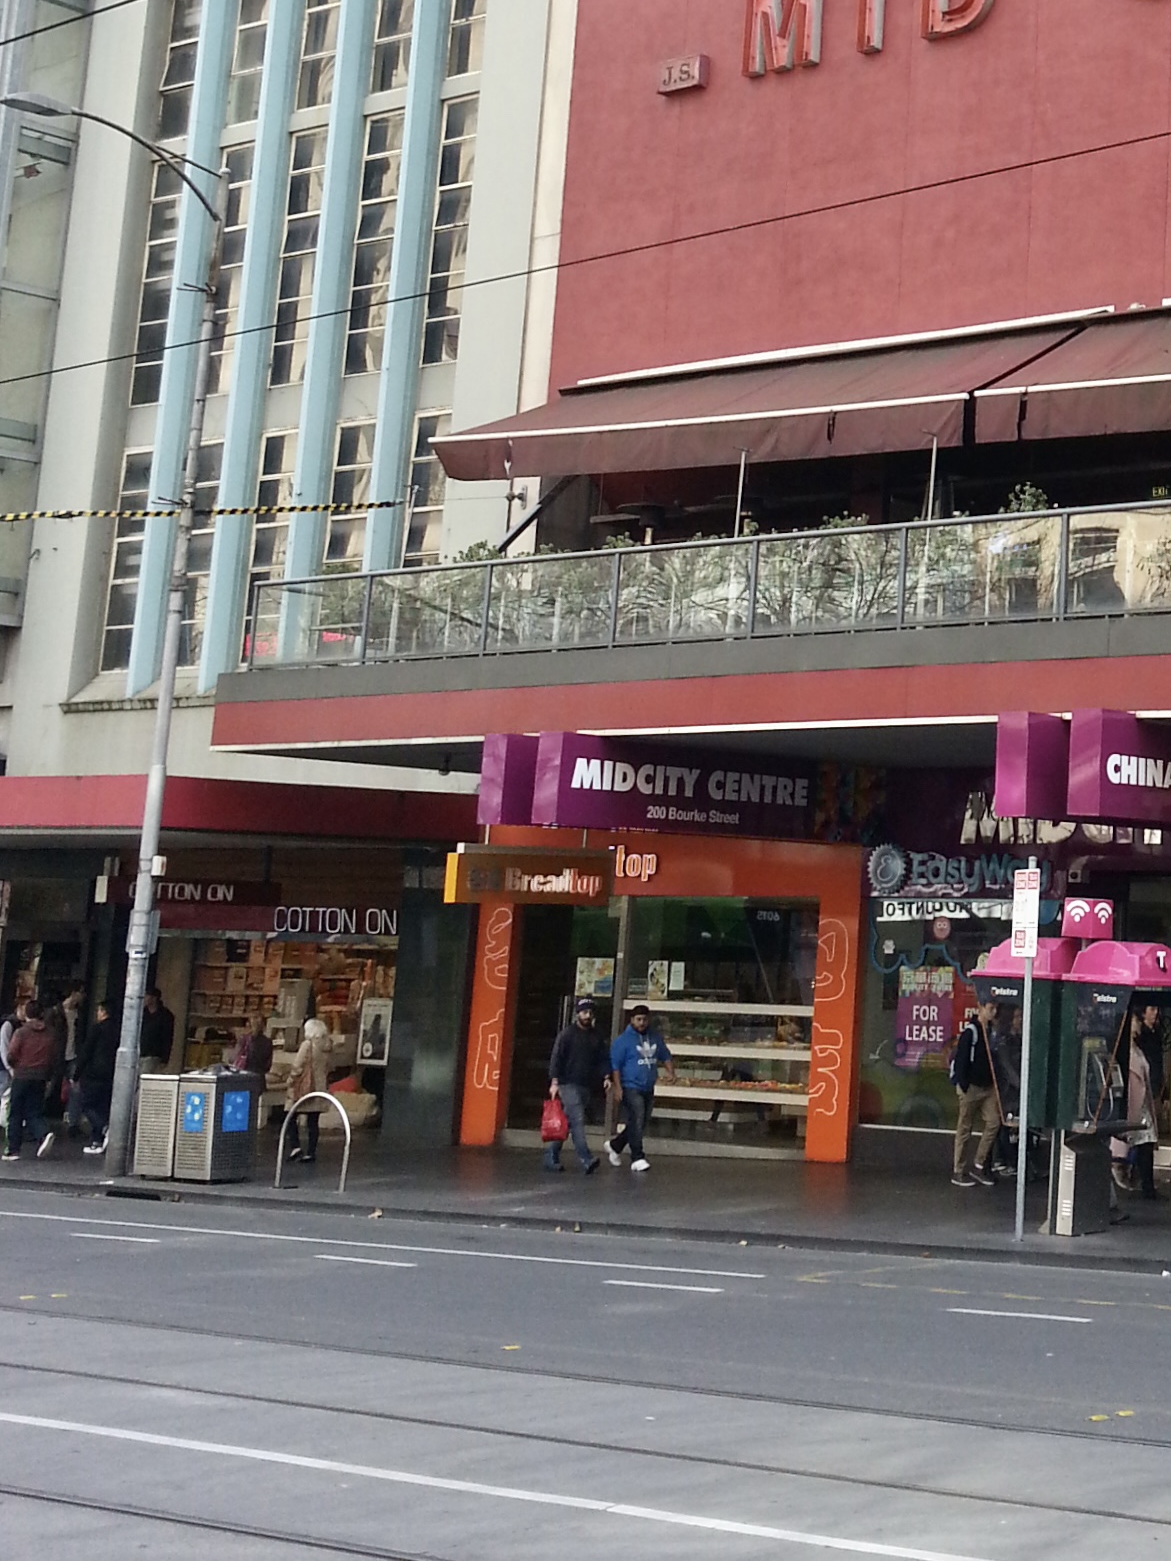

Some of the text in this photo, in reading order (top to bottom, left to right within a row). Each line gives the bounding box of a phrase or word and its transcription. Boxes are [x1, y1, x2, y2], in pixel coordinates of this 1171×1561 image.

[662, 63, 695, 86] J.S.
[570, 757, 809, 806] MIDCITY CENTRE
[646, 805, 740, 824] 200 Bourke Street
[128, 882, 234, 902] CTTON ON
[505, 868, 603, 897] Breadtop
[273, 906, 397, 935] COTTON ON
[913, 1005, 938, 1021] FOR
[905, 1025, 944, 1042] LEASE
